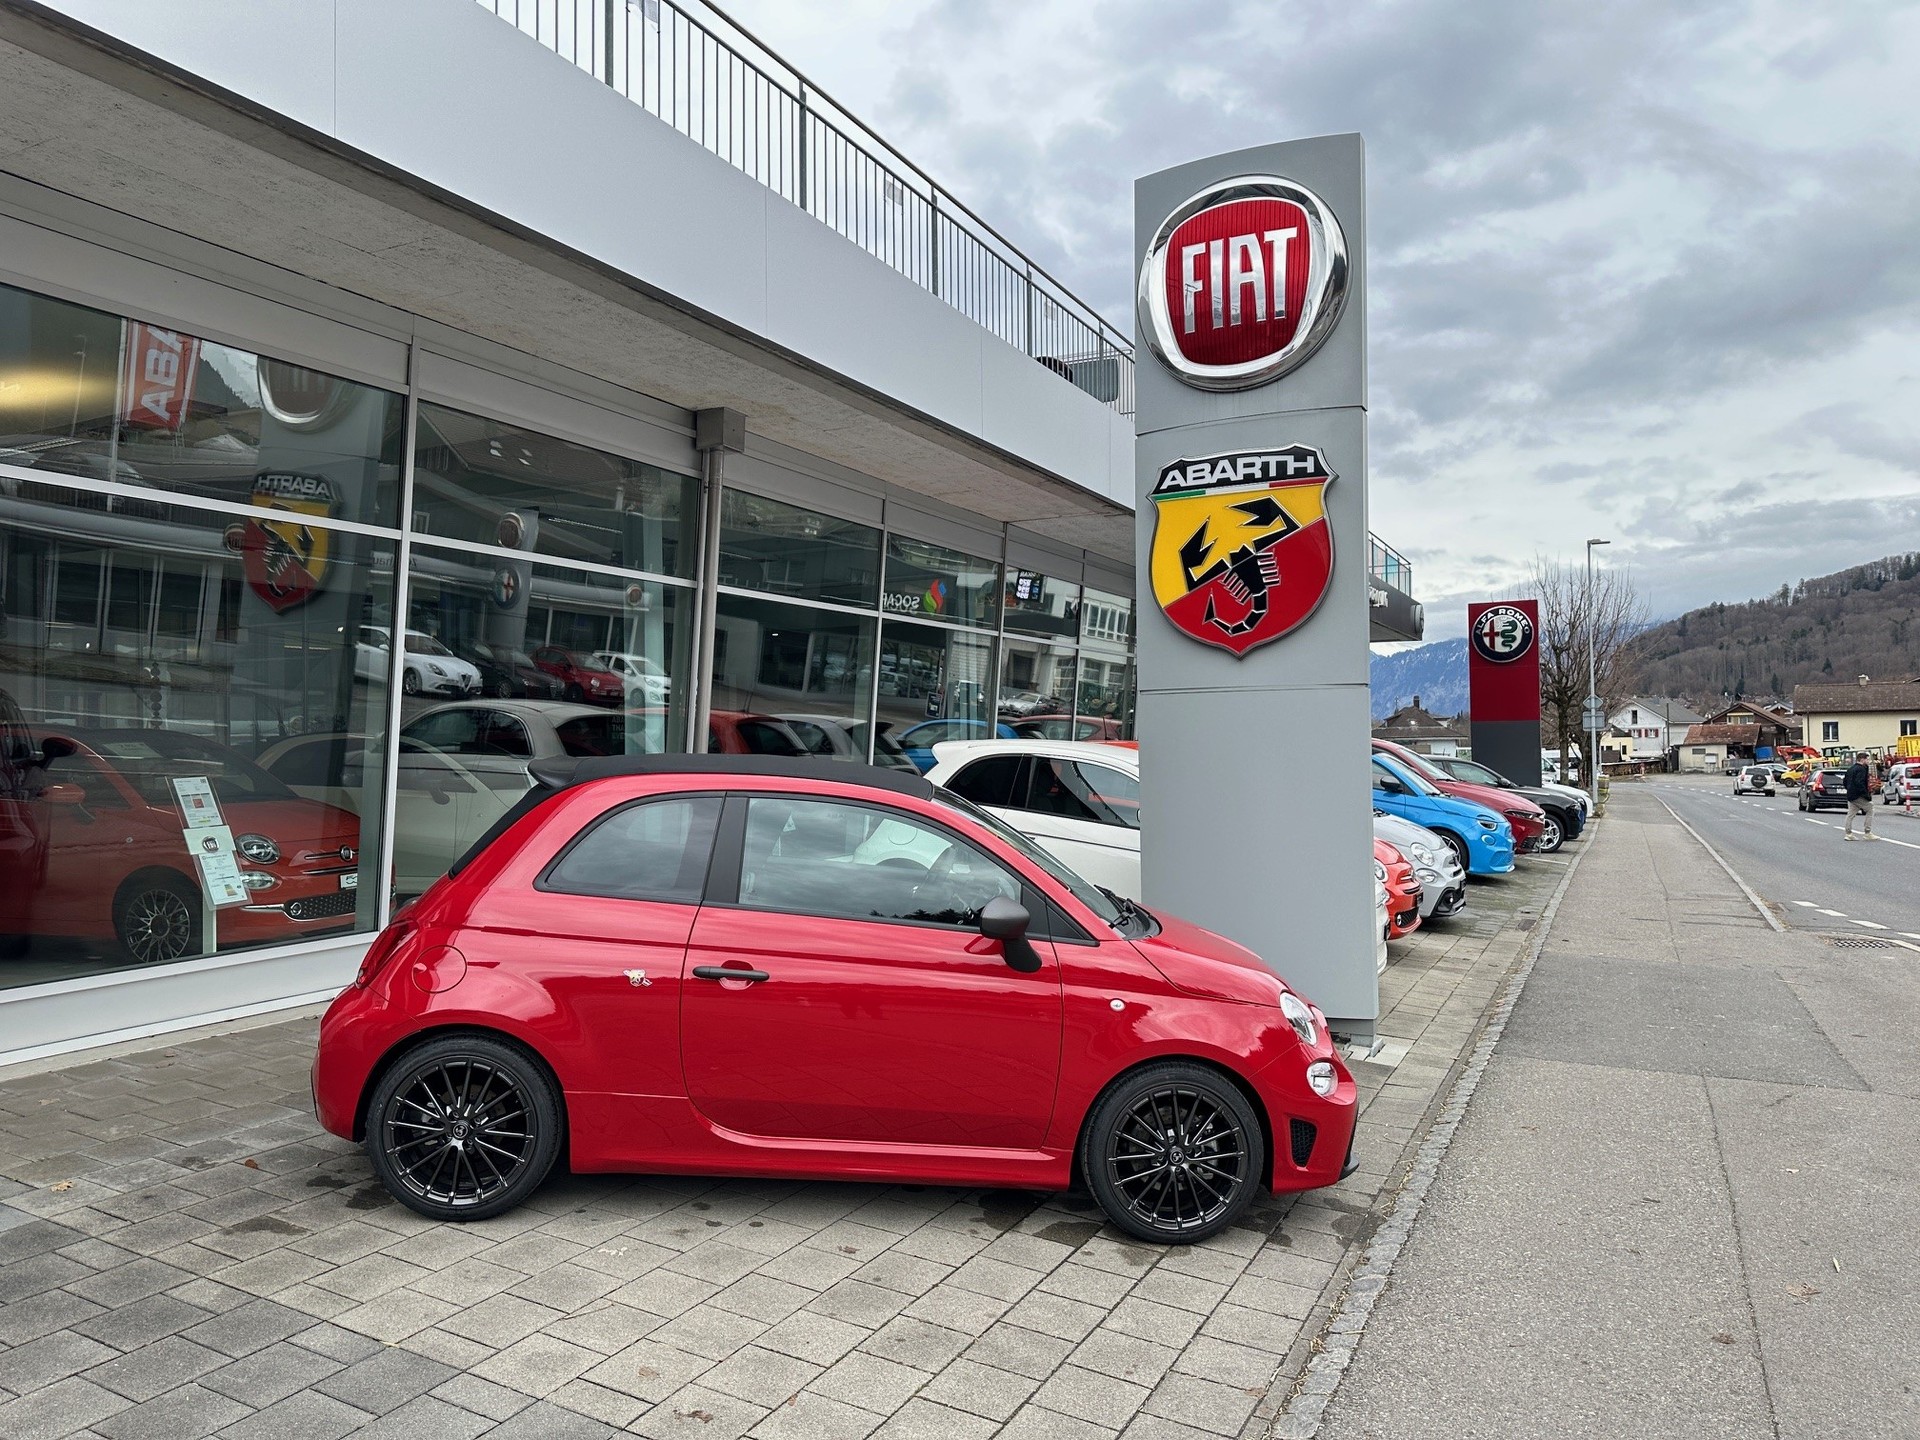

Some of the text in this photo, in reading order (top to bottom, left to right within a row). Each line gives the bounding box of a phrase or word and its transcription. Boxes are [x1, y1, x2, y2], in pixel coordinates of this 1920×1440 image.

[1182, 226, 1298, 335] FIAT
[1160, 455, 1315, 490] ABARTH
[1475, 608, 1530, 635] ALFA ROMEO
